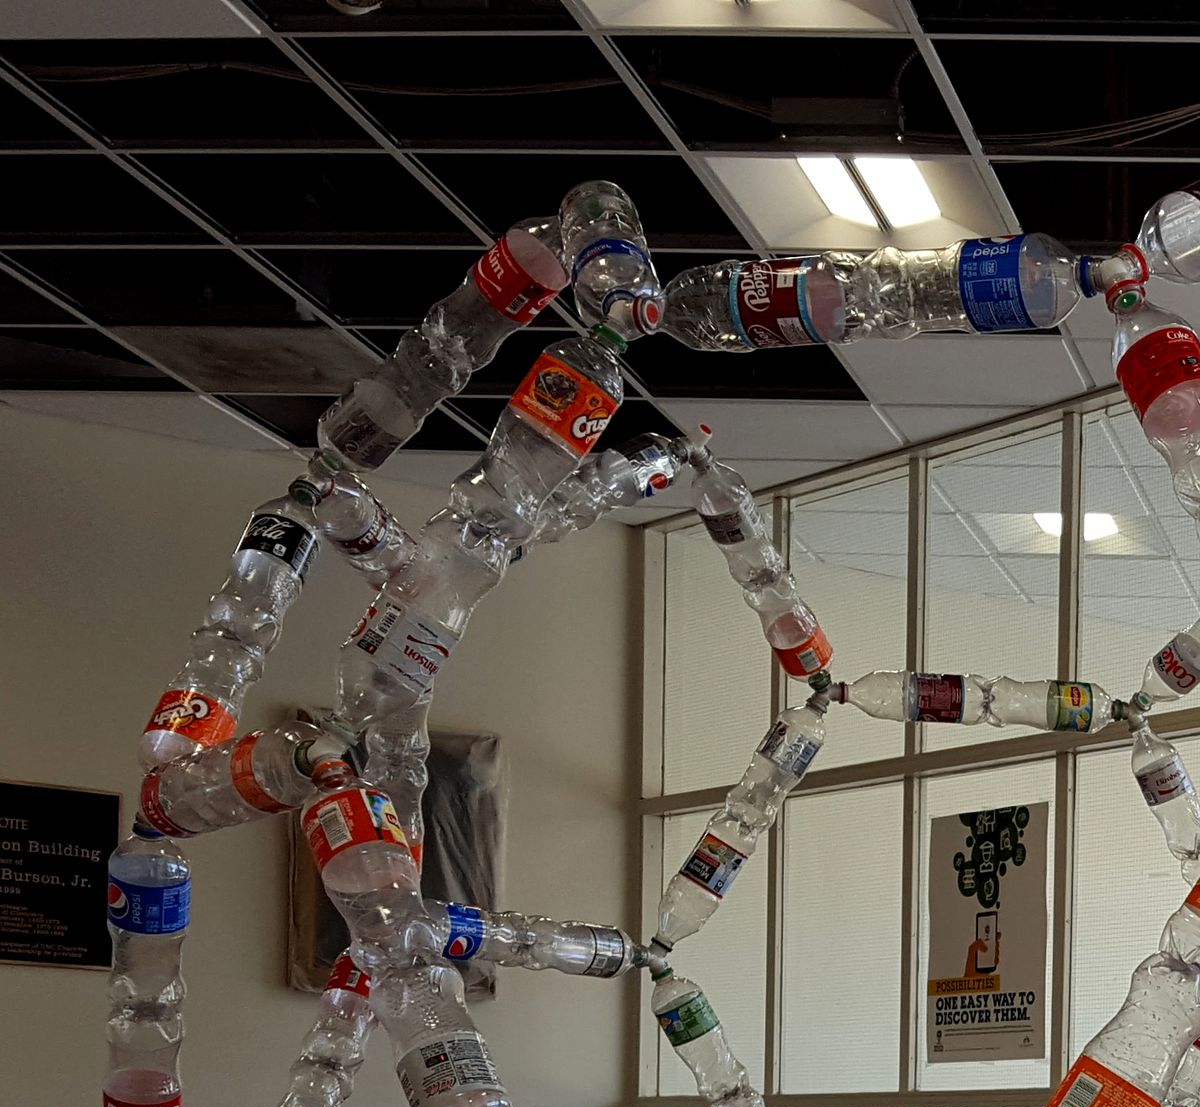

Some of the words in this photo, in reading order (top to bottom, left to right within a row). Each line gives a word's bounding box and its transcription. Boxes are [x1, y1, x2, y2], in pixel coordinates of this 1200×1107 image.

[973, 243, 1009, 259] pepsi
[572, 412, 612, 438] Crus
[1161, 646, 1195, 688] Coke
[28, 840, 101, 862] Building
[71, 874, 92, 888] Jr.
[132, 893, 143, 925] pepsi
[936, 978, 994, 992] POSSIBILITIES
[936, 997, 958, 1010] ONE
[961, 994, 990, 1009] EASY
[992, 992, 1017, 1008] WAY
[1019, 991, 1035, 1005] TO
[936, 1009, 991, 1025] DISCOVER
[994, 1007, 1030, 1021] THEM.
